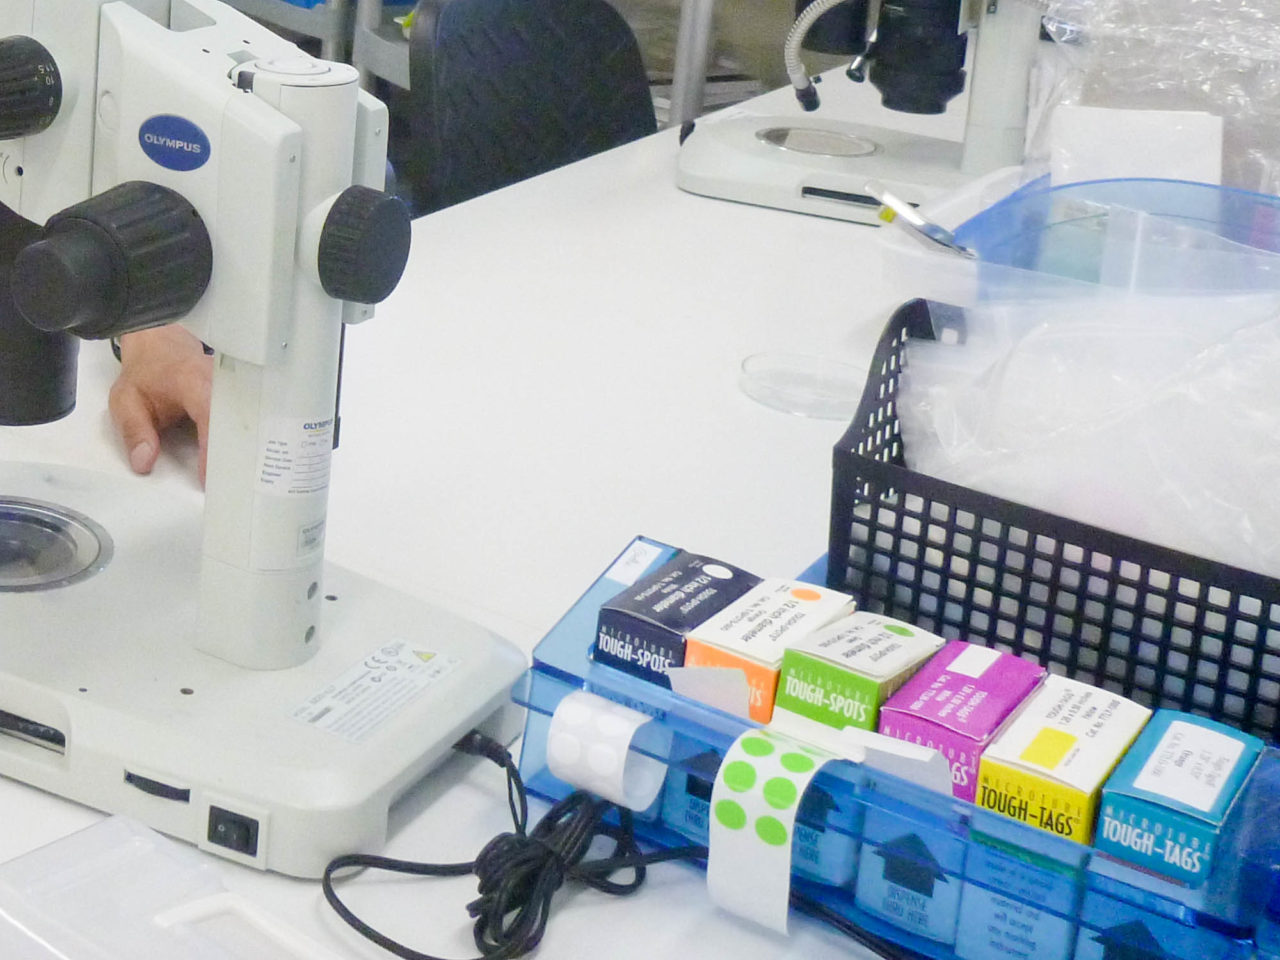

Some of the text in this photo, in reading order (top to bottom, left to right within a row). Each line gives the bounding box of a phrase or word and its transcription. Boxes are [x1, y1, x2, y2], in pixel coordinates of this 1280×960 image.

[144, 133, 201, 153] OLYMPUS
[598, 632, 671, 675] TOUGH-SPOTS
[786, 675, 866, 722] TOUGH-SPOTS
[981, 785, 1073, 837] TOUGH-TAGS
[982, 775, 1082, 817] MICROTUBE
[1102, 815, 1201, 873] TOUGH-TAGS
[1104, 805, 1211, 852] MICROTUBE
